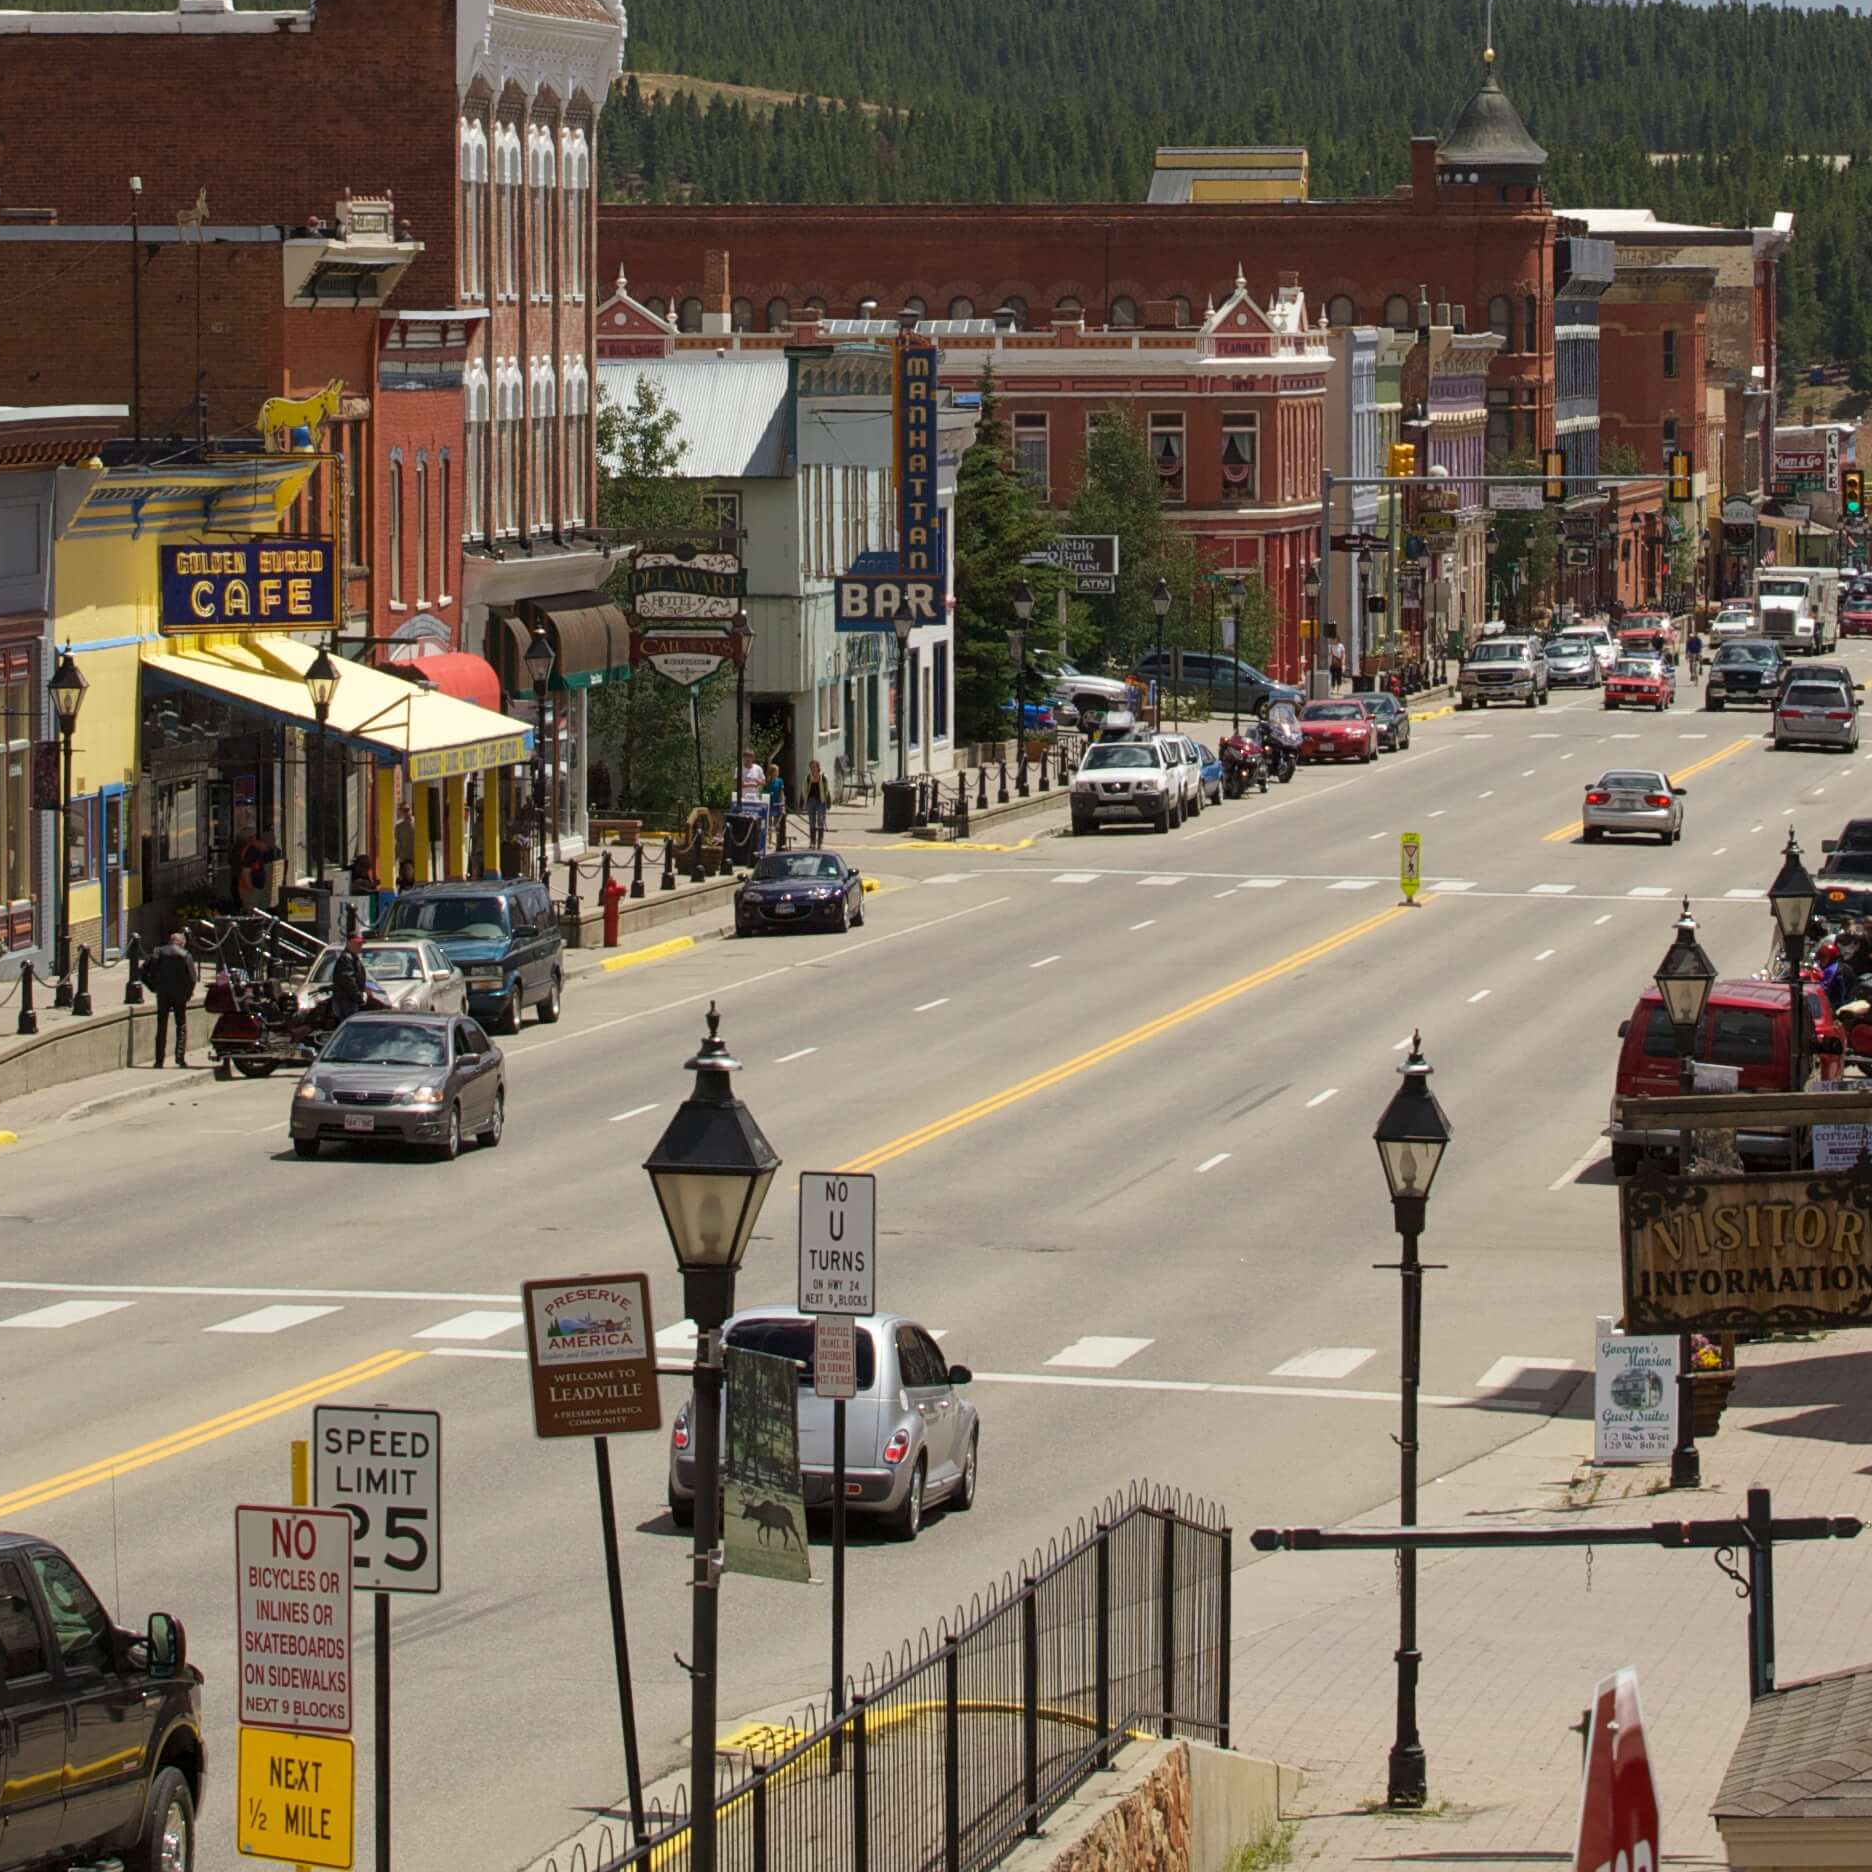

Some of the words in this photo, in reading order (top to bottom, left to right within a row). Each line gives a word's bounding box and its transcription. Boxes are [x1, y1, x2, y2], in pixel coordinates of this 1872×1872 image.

[907, 356, 927, 570] MANHATTAN
[1807, 454, 1822, 467] Go
[1827, 432, 1838, 489] CAFE
[177, 551, 247, 575] GOLDEN
[258, 549, 323, 574] BURRO
[1080, 579, 1109, 589] ATM
[191, 578, 313, 618] CAFE
[652, 595, 696, 607] HOTEL
[841, 582, 937, 618] BAR
[1815, 1131, 1861, 1142] COTTAGE
[825, 1181, 849, 1203] NO
[829, 1210, 844, 1242] U
[1652, 1201, 1866, 1262] VISITOR
[809, 1249, 865, 1272] TURNS
[812, 1278, 824, 1290] ON
[827, 1279, 844, 1291] HWY
[849, 1280, 860, 1291] 24
[544, 1288, 633, 1316] PRESERVE
[805, 1293, 824, 1305] NEXT
[838, 1295, 868, 1307] BLOCKS
[548, 1332, 633, 1350] AMERICA
[1601, 1340, 1659, 1358] Governor's
[1624, 1353, 1672, 1367] Mansion
[554, 1370, 615, 1383] WELCOME
[618, 1369, 636, 1378] TO
[561, 1408, 602, 1419] PRESERVE
[603, 1406, 643, 1416] AMERICA
[568, 1416, 627, 1427] COMMUNITY
[1601, 1409, 1634, 1426] Guest
[1636, 1409, 1670, 1423] Suites
[324, 1427, 430, 1459] SPEED
[1621, 1432, 1645, 1441] Block
[1647, 1432, 1670, 1441] West
[336, 1465, 417, 1496] LIMIT
[271, 1518, 317, 1560] NO
[331, 1503, 428, 1572] 25
[248, 1566, 316, 1593] BICYCLES
[319, 1571, 341, 1595] OR
[256, 1598, 310, 1625] INLINES
[313, 1603, 334, 1627] OR
[245, 1630, 345, 1660] SKATEBOARDS
[244, 1663, 265, 1685] ON
[268, 1666, 346, 1694] SIDEWALKS
[246, 1696, 279, 1714] NEXT
[282, 1699, 289, 1715] 9
[293, 1699, 345, 1720] BLOCKS
[269, 1756, 323, 1793] NEXT
[284, 1803, 332, 1841] MILE
